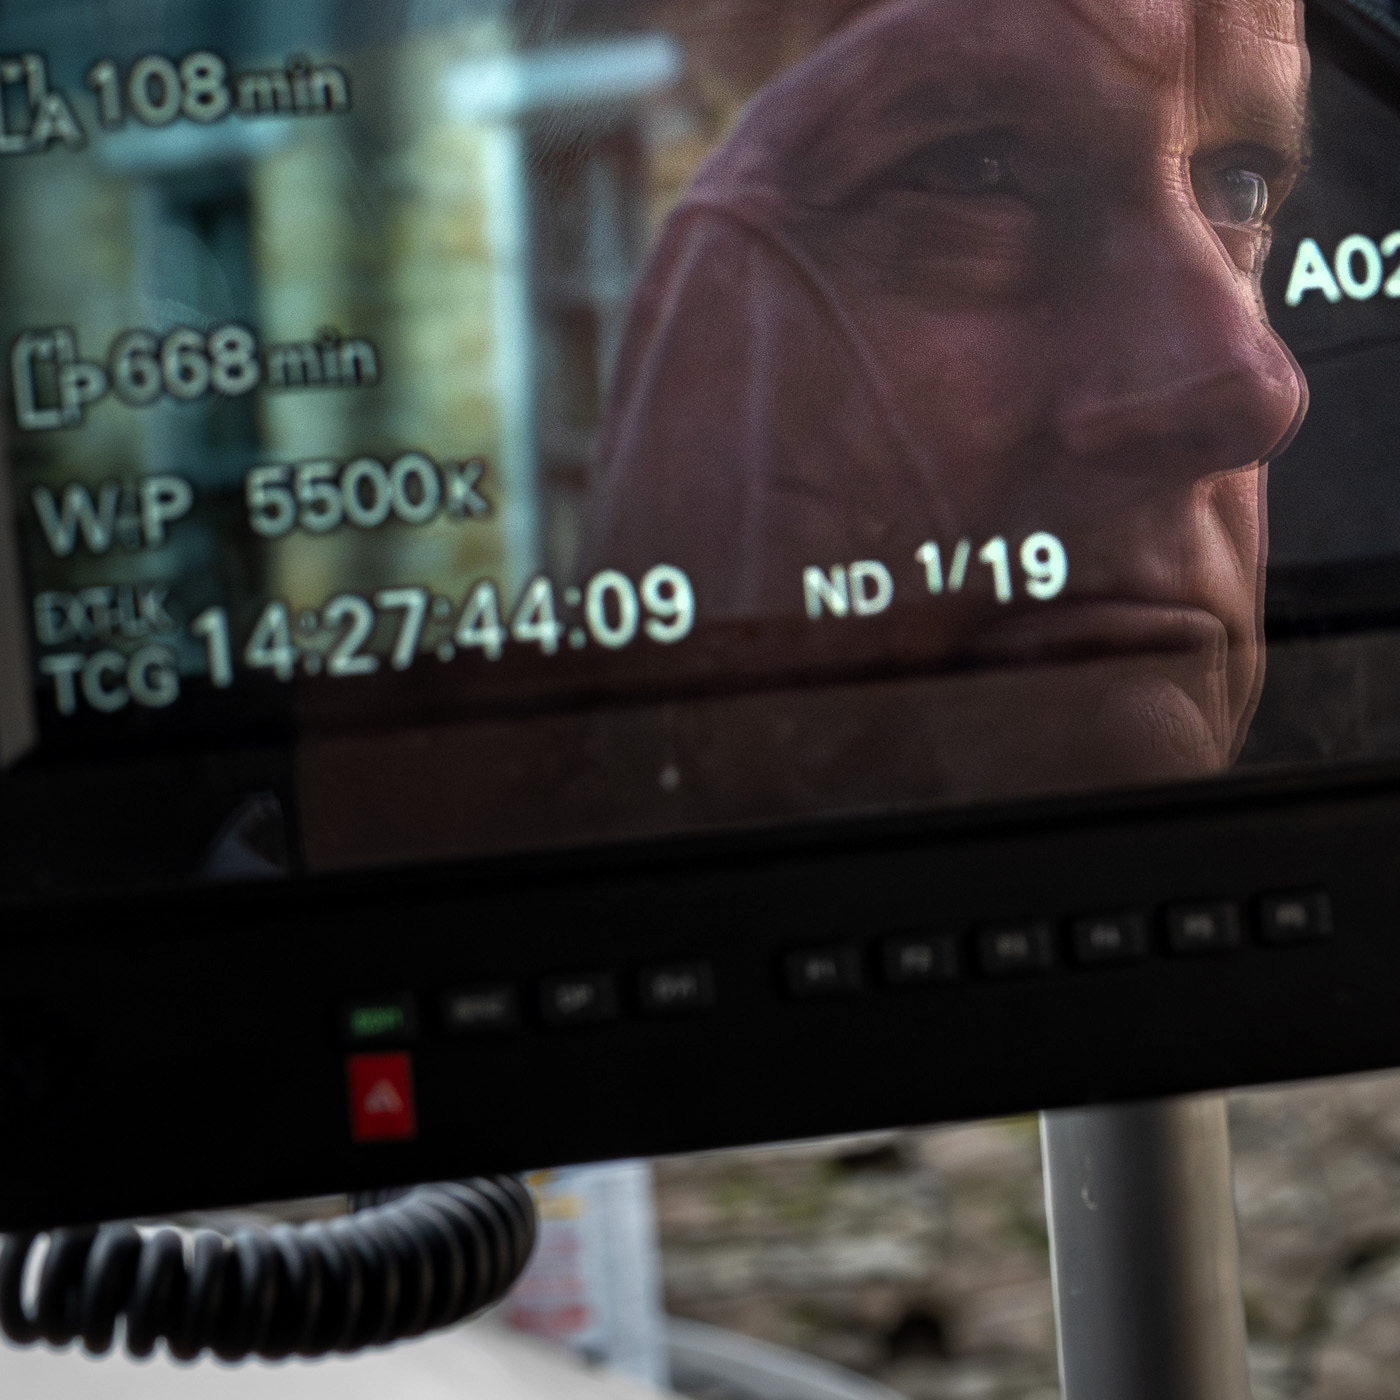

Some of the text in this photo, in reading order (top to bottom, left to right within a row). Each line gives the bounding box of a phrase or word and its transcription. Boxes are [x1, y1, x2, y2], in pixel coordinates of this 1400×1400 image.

[802, 531, 1070, 622] ND 1/19
[38, 562, 697, 718] TCG 14:27:44:09
